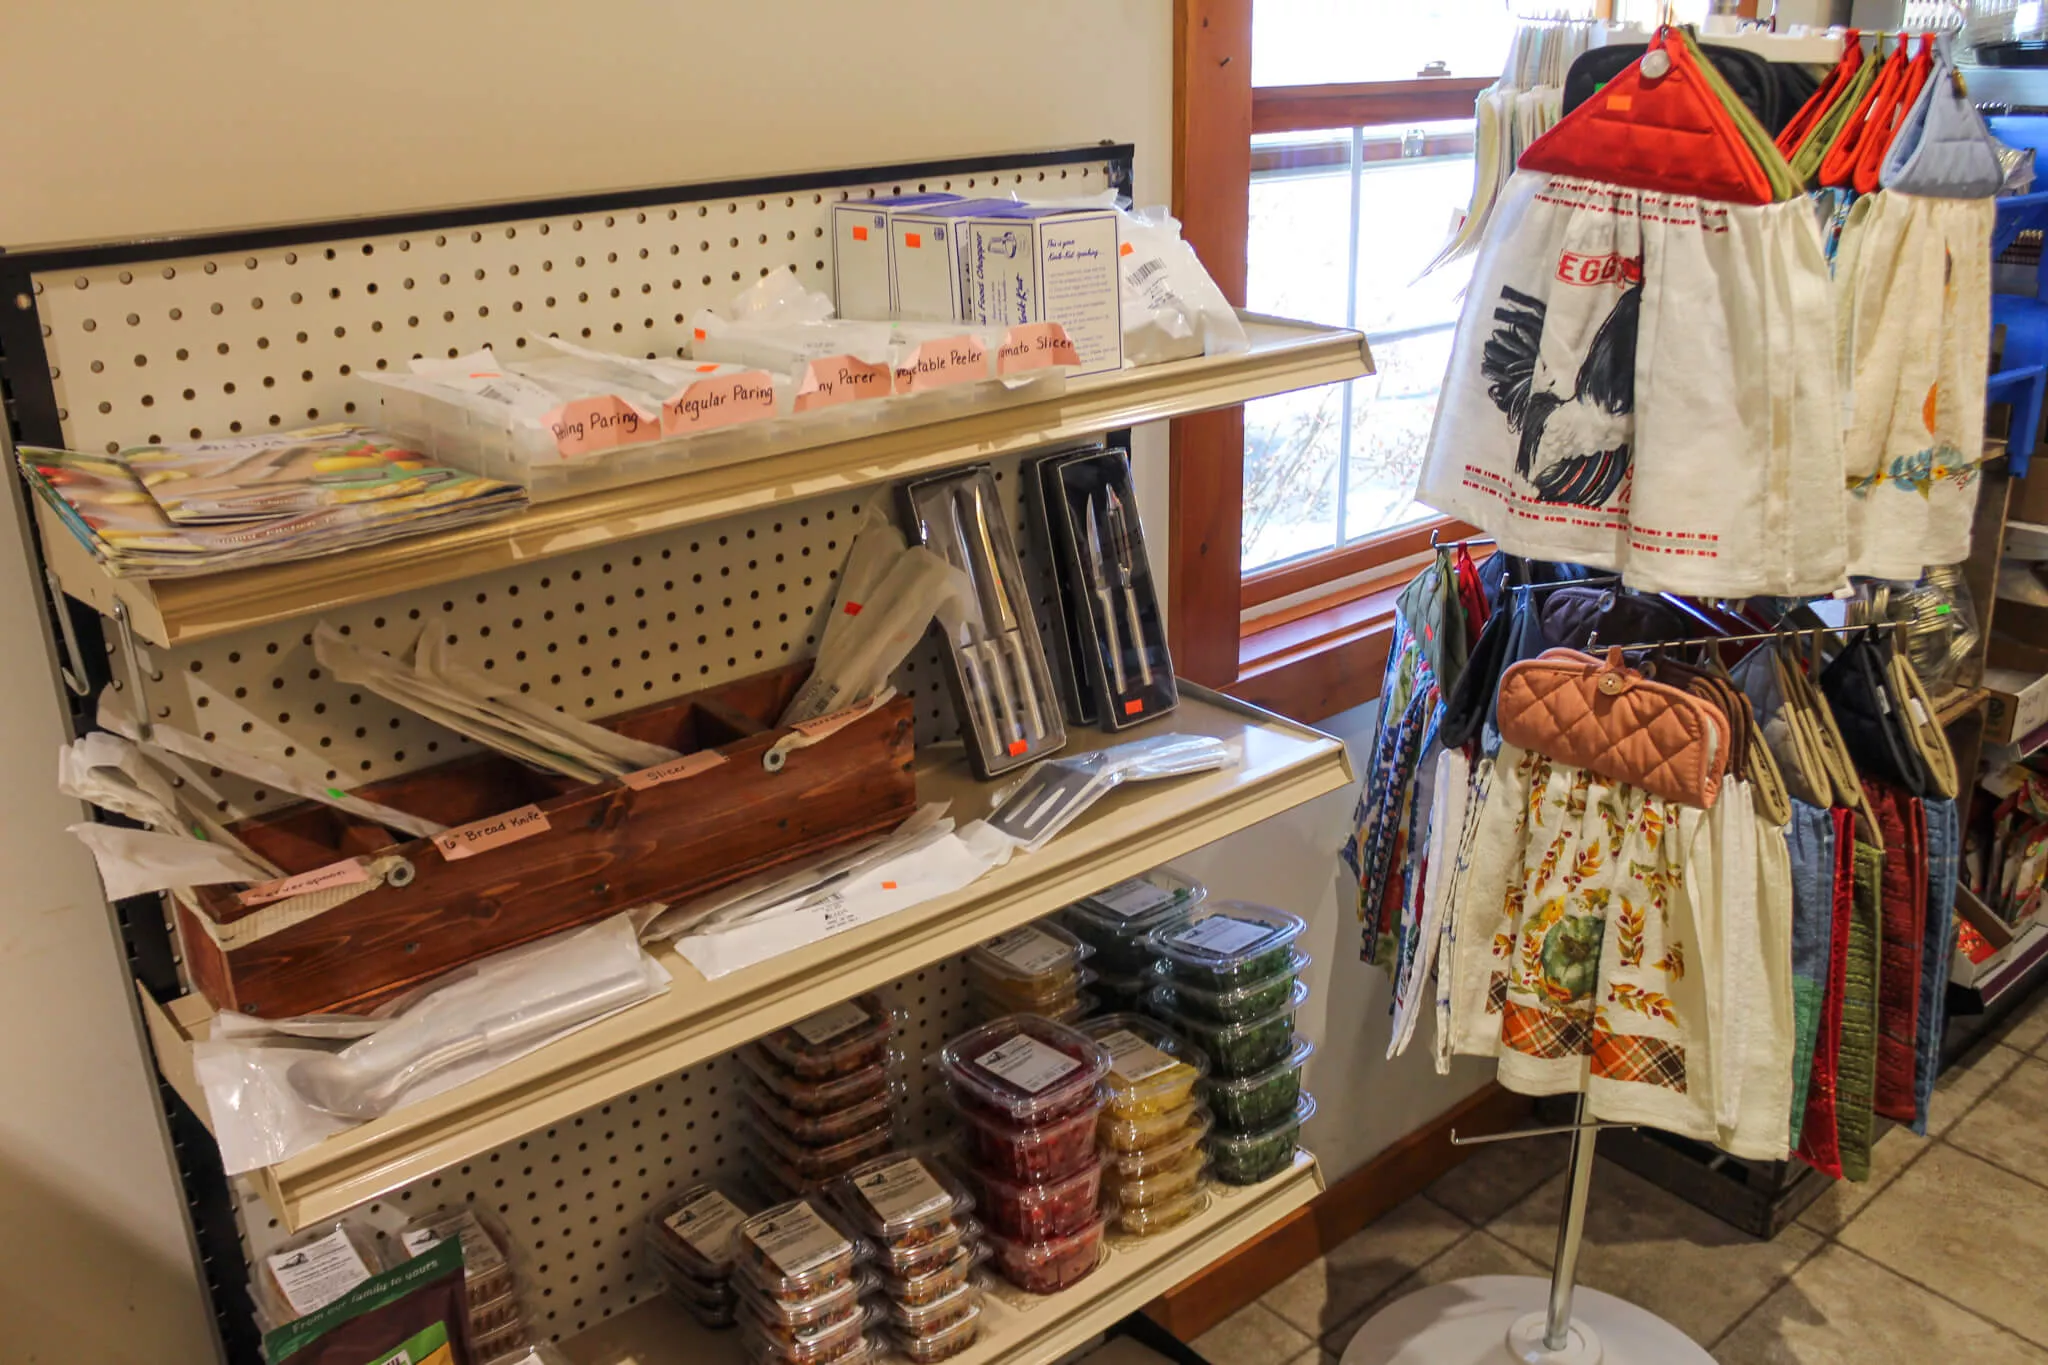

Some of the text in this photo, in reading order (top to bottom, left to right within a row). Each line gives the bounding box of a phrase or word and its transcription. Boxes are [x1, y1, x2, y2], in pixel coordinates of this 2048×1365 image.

[976, 231, 985, 279] Chopper
[977, 283, 985, 311] Food
[1000, 341, 1030, 358] omato
[1036, 335, 1072, 350] Slicer
[950, 350, 982, 366] Peeler
[839, 367, 876, 385] Parer
[733, 384, 773, 405] Paring
[590, 411, 638, 433] Paring
[647, 765, 685, 780] Slicer
[465, 821, 506, 841] Bread
[510, 811, 541, 827] Knife
[292, 1259, 439, 1333] From our family to yours
